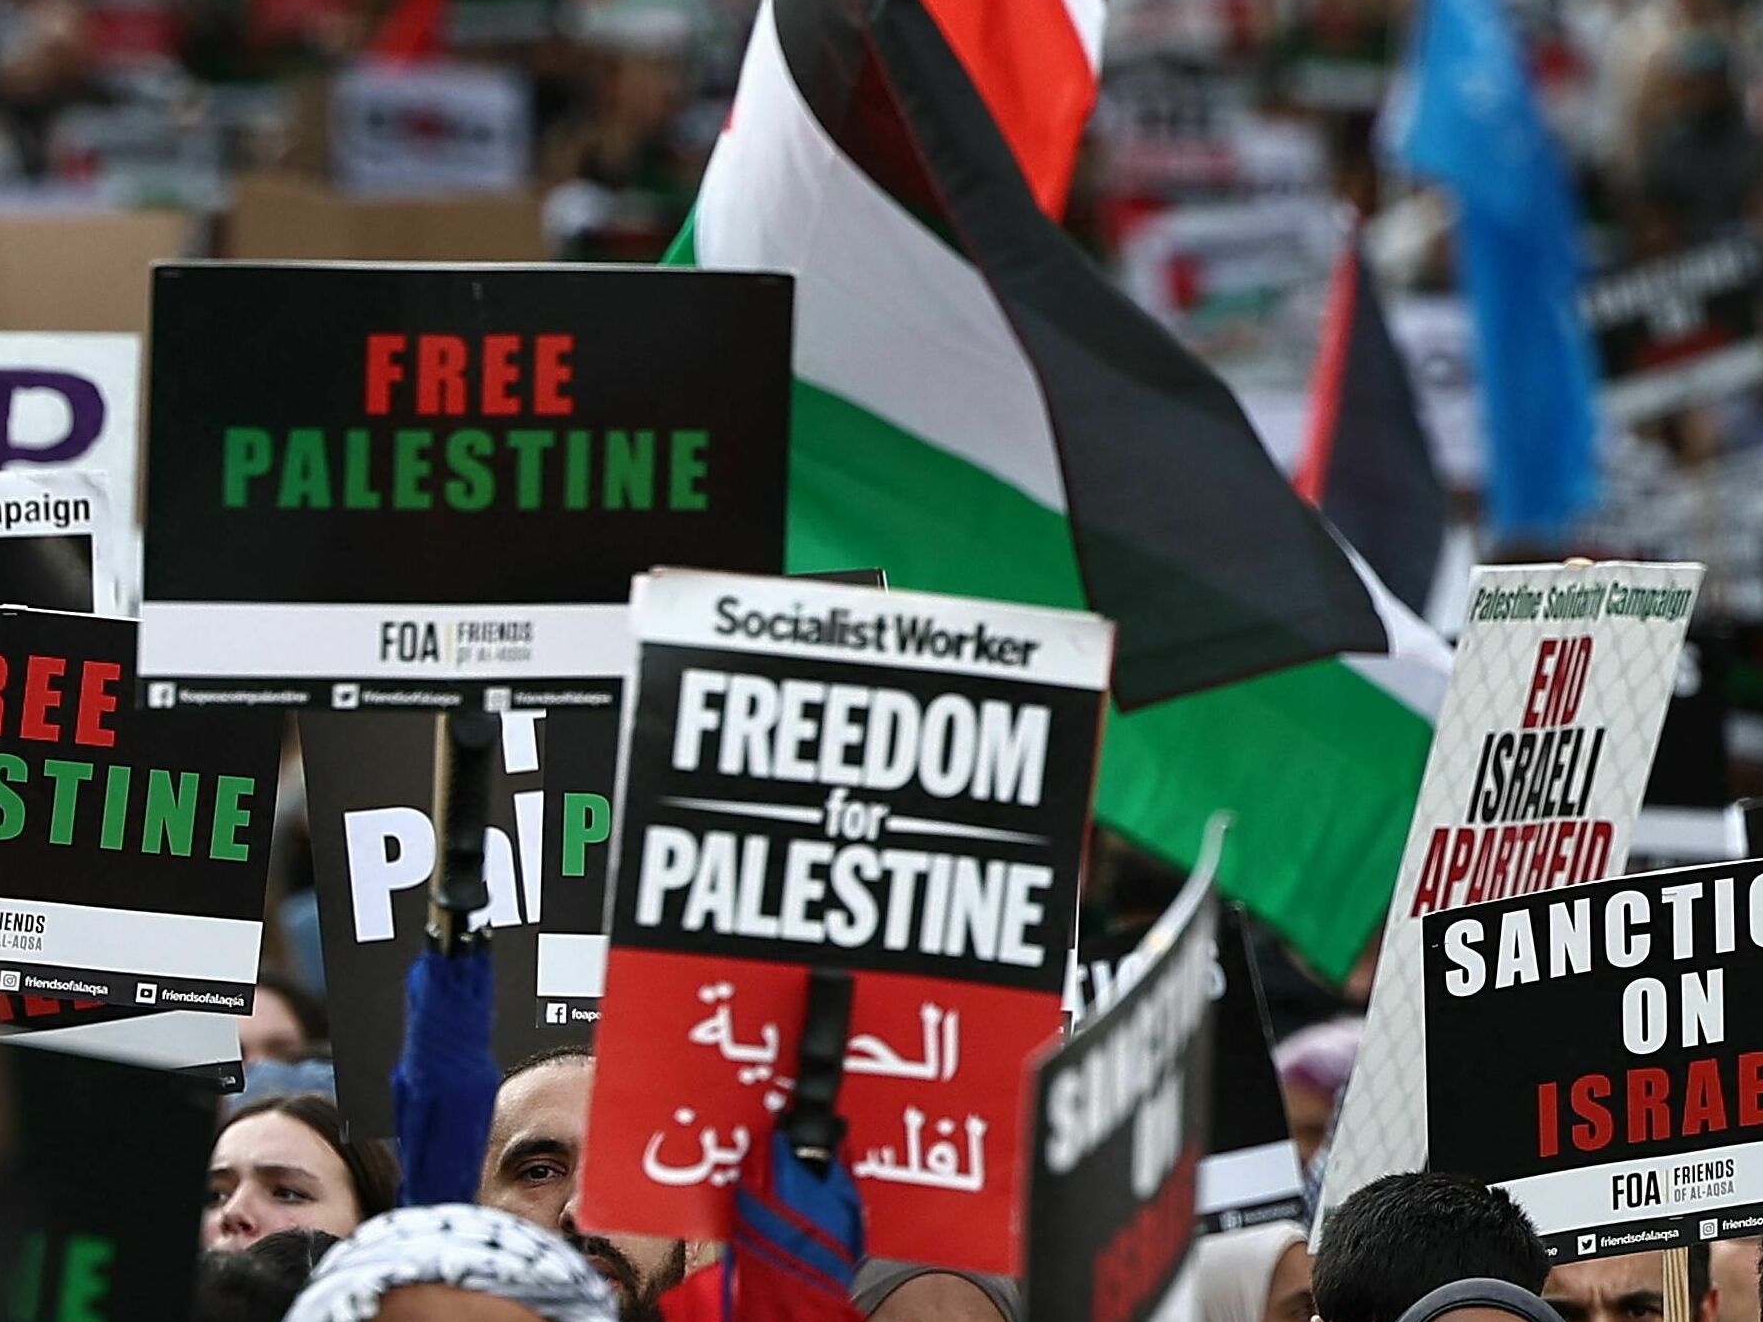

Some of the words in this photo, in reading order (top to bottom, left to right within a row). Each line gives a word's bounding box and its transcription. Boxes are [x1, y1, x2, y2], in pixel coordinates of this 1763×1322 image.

[364, 333, 574, 416] FREE
[222, 427, 710, 511] PALESTINE
[713, 597, 888, 653] Socialist
[892, 614, 1039, 670] Worker
[1468, 585, 1544, 624] Palestine
[1606, 581, 1694, 626] Campaign
[380, 621, 440, 663] FOA
[1522, 635, 1594, 729] END
[672, 668, 1052, 807] FREEDOM
[1467, 727, 1606, 824] ISRAELI
[822, 789, 887, 841] for
[636, 825, 1054, 967] PALESTINE
[1410, 819, 1615, 919] APARTHEID
[24, 974, 109, 997] friendsofalaqsa
[161, 988, 245, 1009] friendsofalaqsa
[1622, 967, 1726, 1056] ON
[1611, 1170, 1662, 1211] FOA
[1673, 1188, 1688, 1203] OF
[1690, 1180, 1735, 1200] AL-AQSA
[1673, 1158, 1735, 1187] FRIENDS
[1600, 1228, 1680, 1249] friendsofalaqsa
